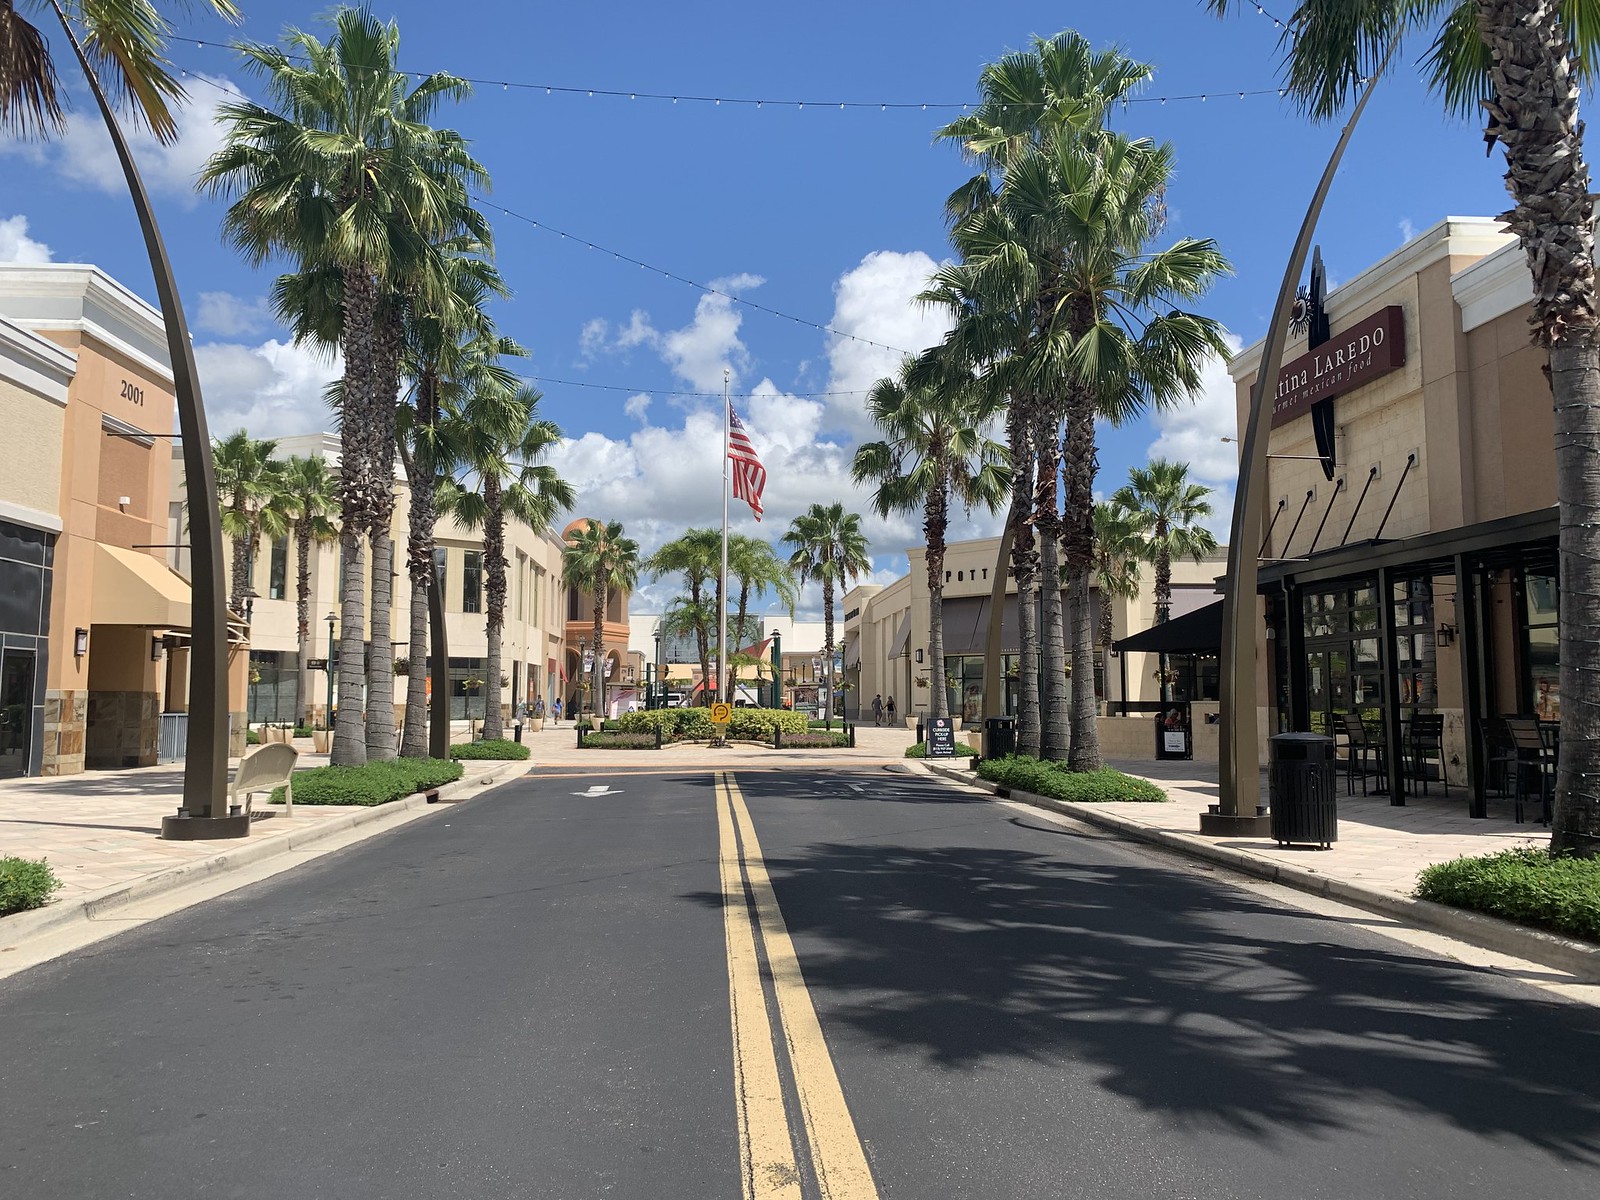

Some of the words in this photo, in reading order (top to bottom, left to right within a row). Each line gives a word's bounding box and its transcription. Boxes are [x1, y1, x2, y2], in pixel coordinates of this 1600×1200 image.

[1302, 371, 1342, 400] mexican
[1346, 352, 1372, 381] food
[1313, 327, 1384, 379] LAREDO
[120, 379, 144, 407] 2001
